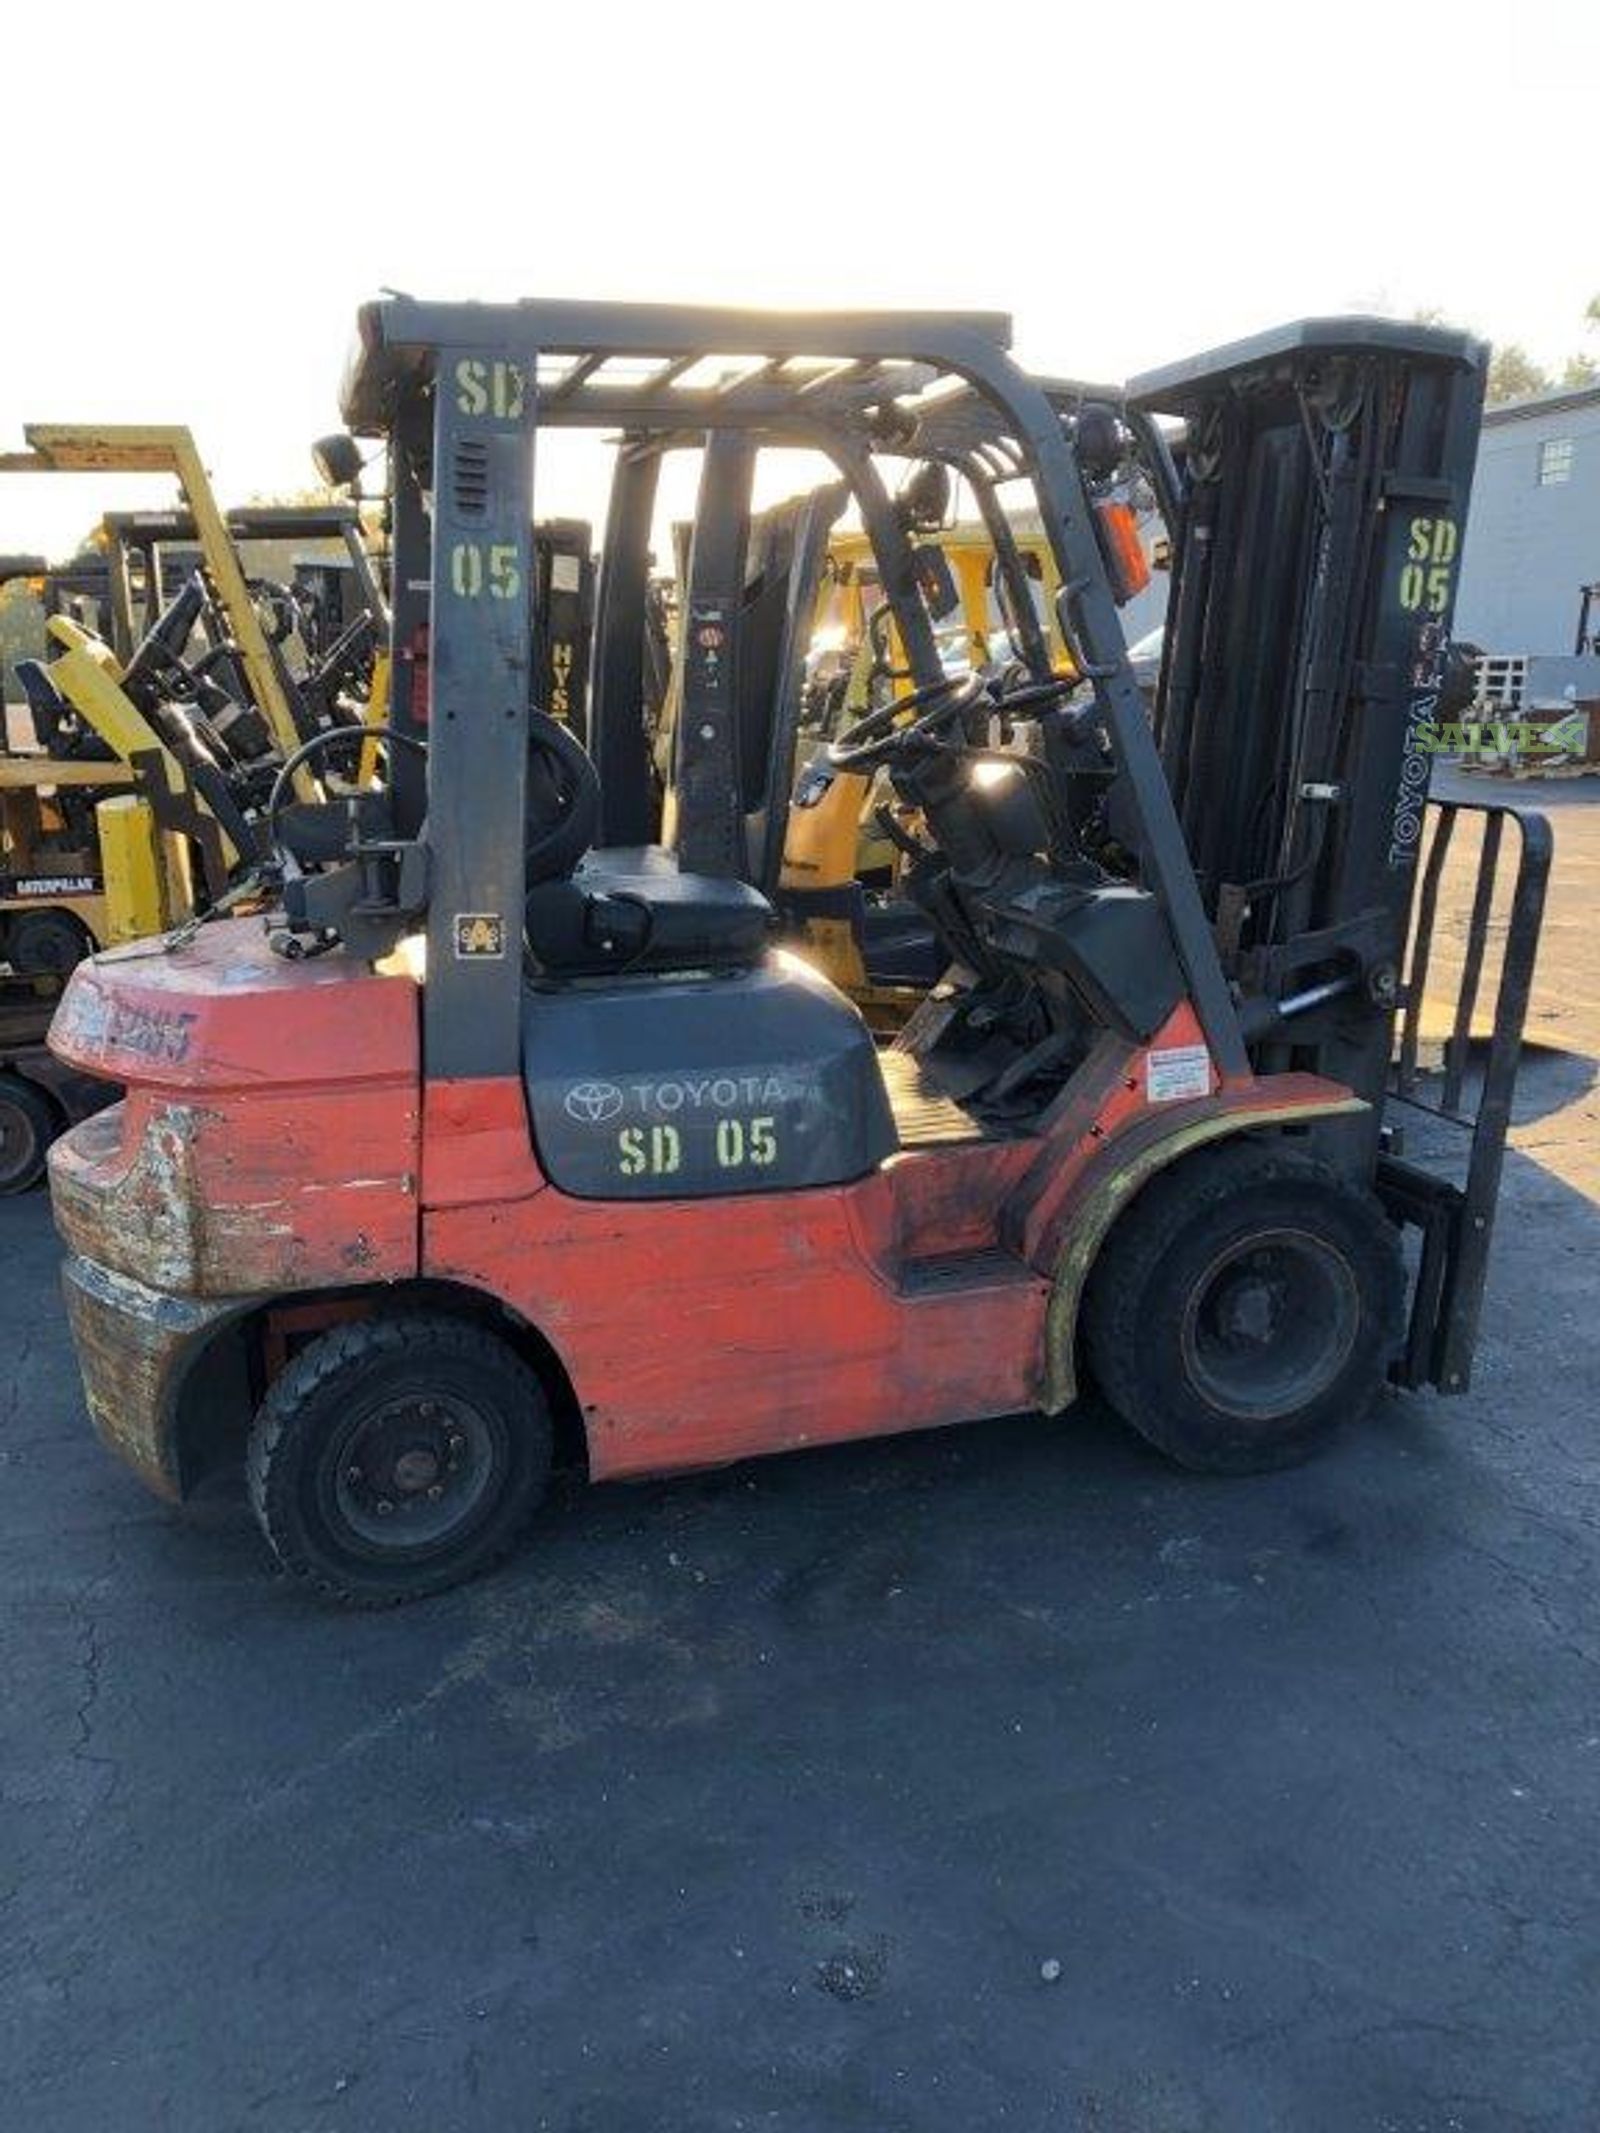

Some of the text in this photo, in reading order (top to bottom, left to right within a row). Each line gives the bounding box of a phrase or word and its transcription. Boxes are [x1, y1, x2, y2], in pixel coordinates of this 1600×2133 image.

[455, 359, 525, 419] SD
[1407, 517, 1457, 564] SD
[452, 543, 521, 598] 05
[1400, 563, 1450, 612] 05
[1388, 694, 1440, 866] TOYOTA
[631, 1076, 788, 1113] TOYOTA
[618, 1116, 776, 1175] SD 05
